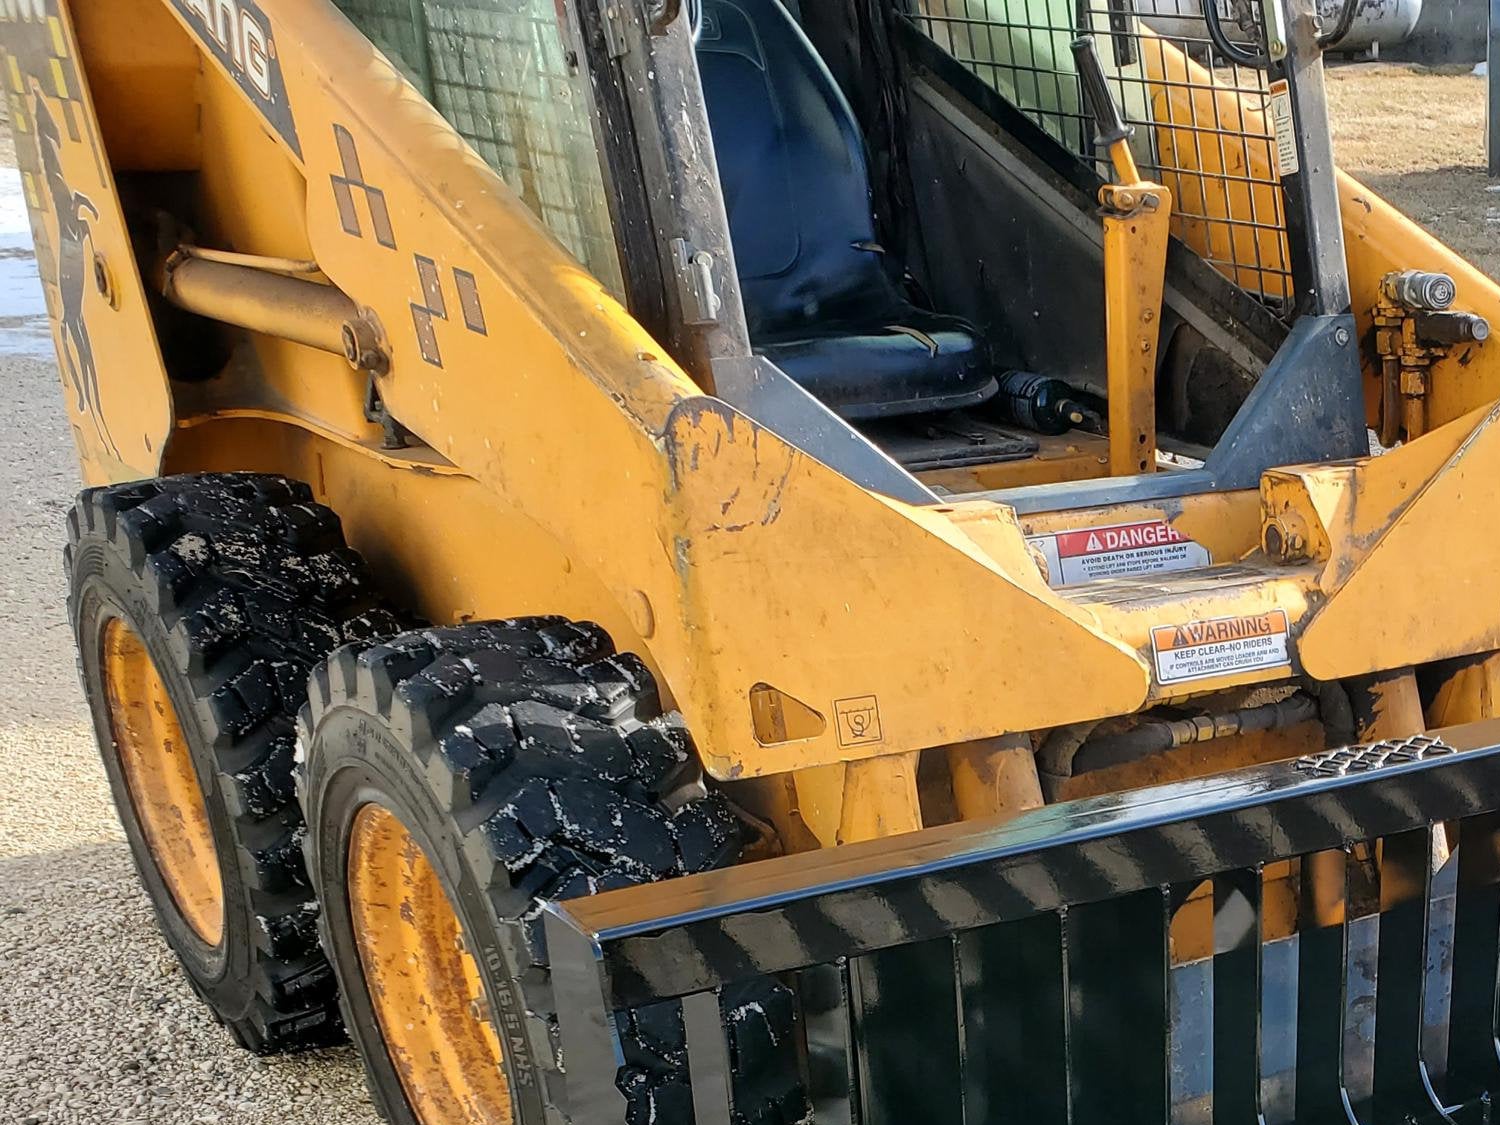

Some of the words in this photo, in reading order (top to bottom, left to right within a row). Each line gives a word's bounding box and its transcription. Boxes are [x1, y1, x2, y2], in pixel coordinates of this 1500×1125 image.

[1082, 556, 1101, 565] AVOID
[1103, 554, 1124, 563] DEATH
[1126, 553, 1134, 561] OR
[1136, 549, 1163, 558] SERIOUS
[1164, 546, 1187, 554] INJURY
[1187, 617, 1272, 643] WARNING
[1174, 650, 1197, 660] KEEP
[1243, 637, 1273, 649] RIDERS
[1175, 660, 1204, 669] CONTROLS
[1216, 655, 1234, 664] MOVED
[1235, 652, 1256, 660] LOADER
[1187, 663, 1222, 673] ATTACHMENT
[511, 1036, 533, 1088] NHS
